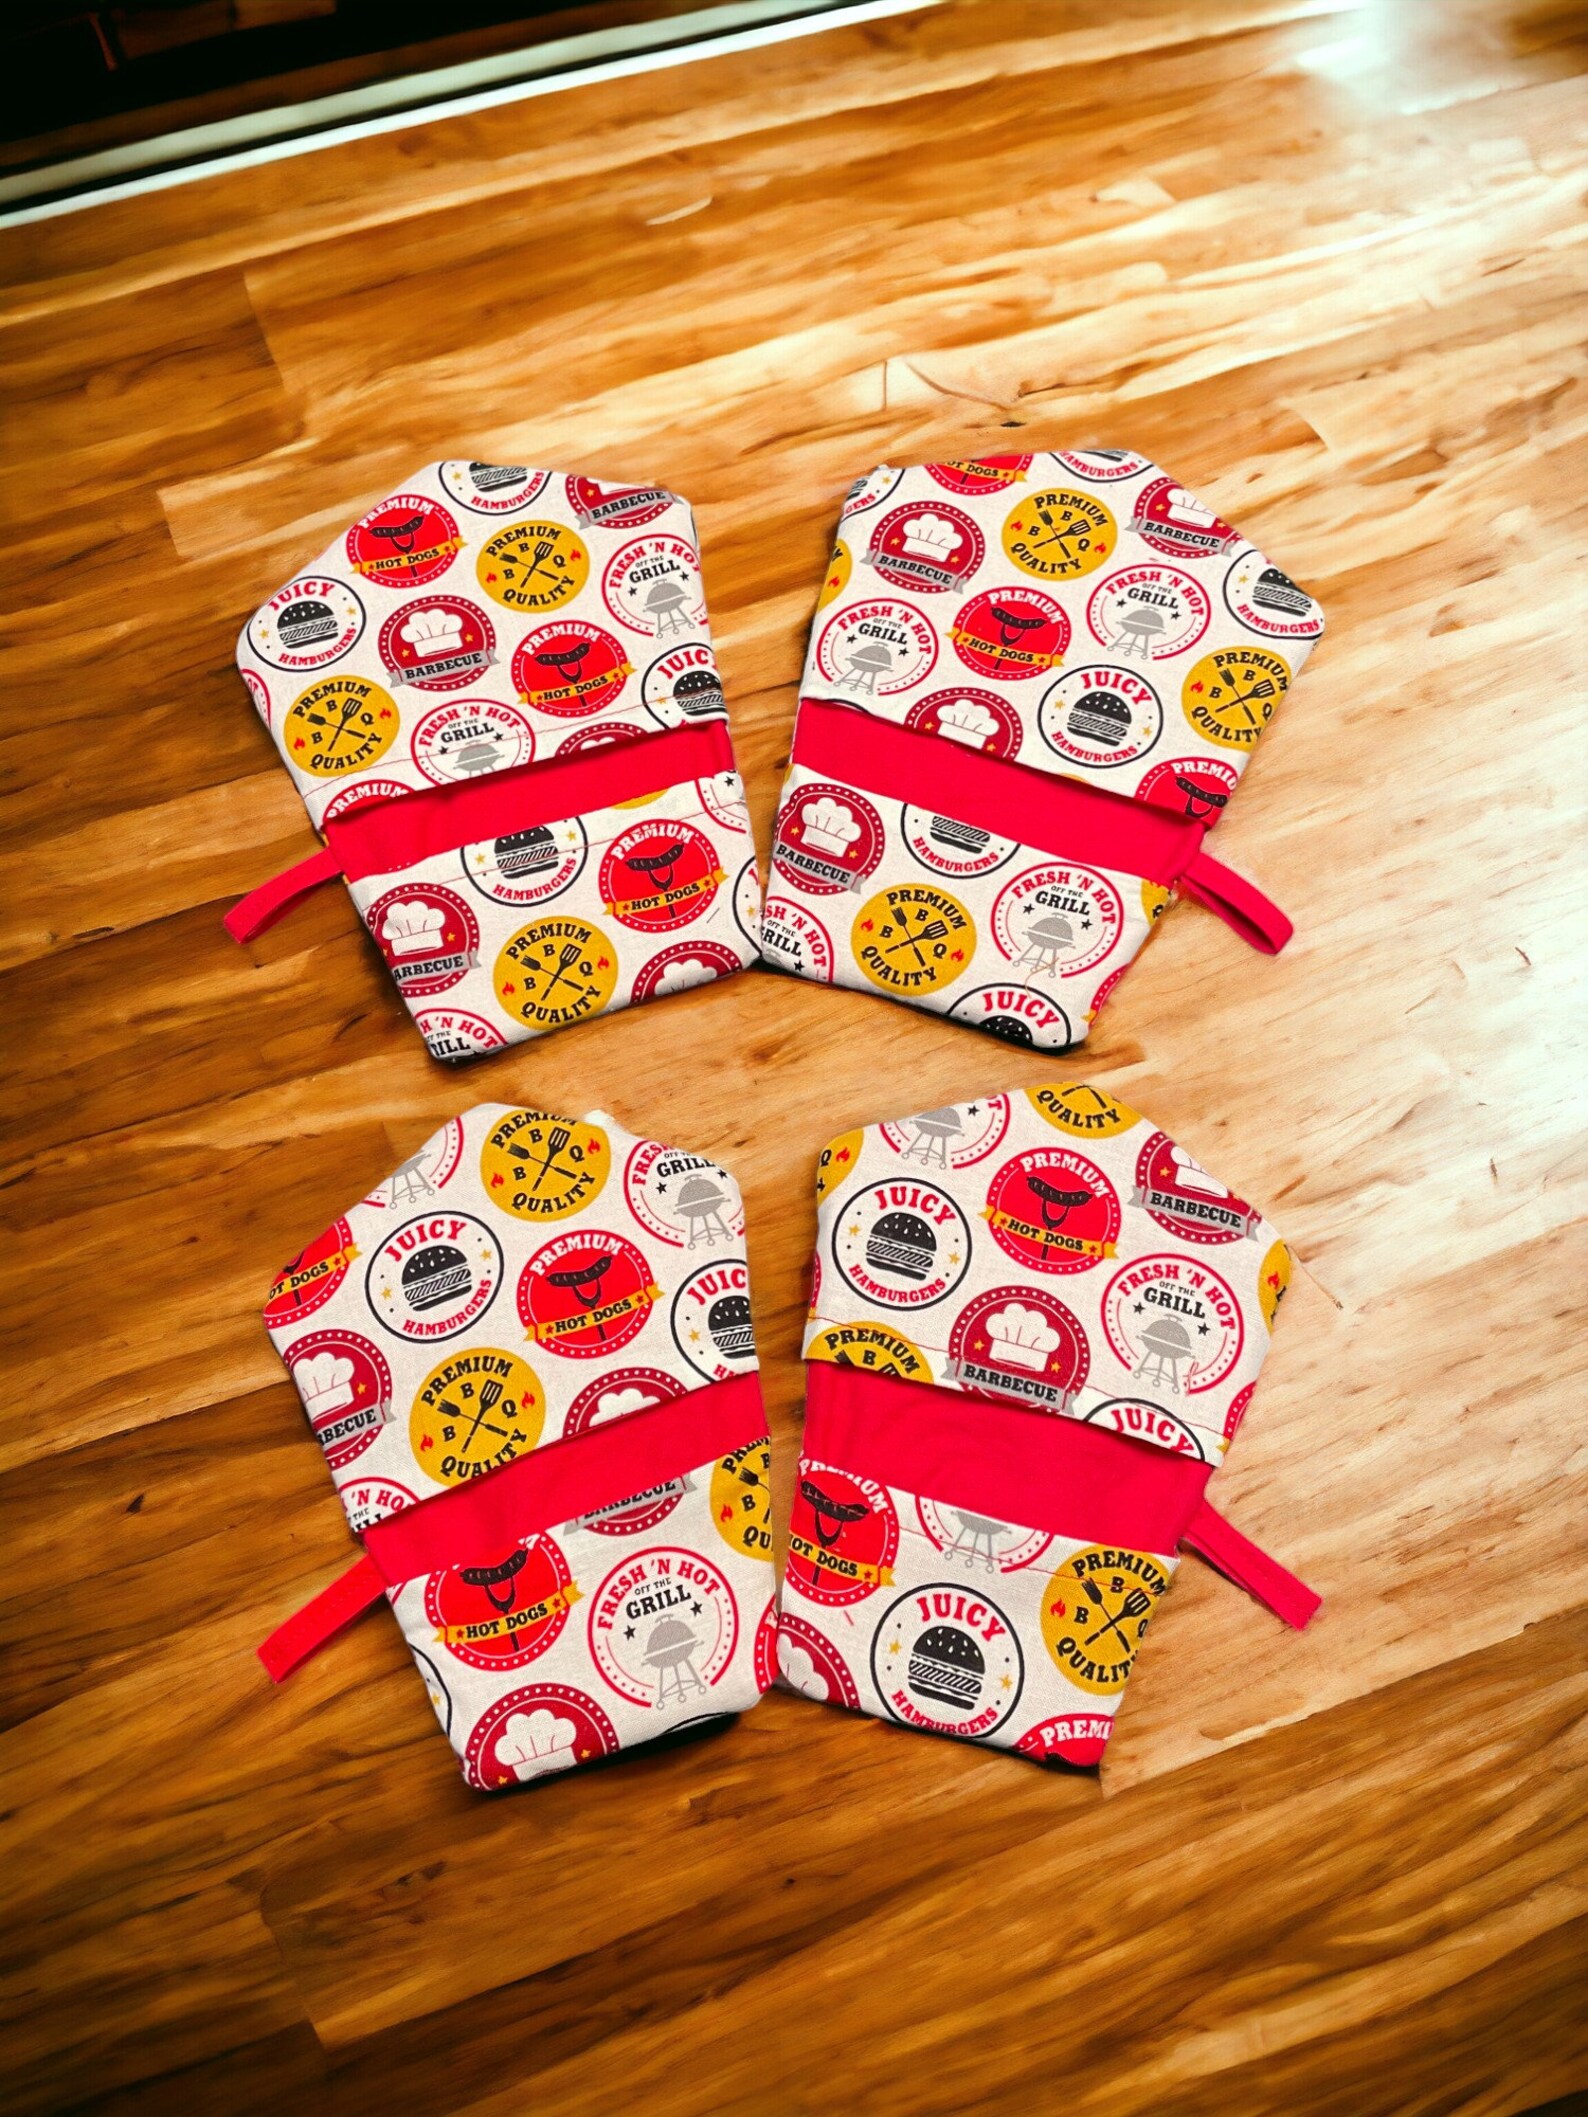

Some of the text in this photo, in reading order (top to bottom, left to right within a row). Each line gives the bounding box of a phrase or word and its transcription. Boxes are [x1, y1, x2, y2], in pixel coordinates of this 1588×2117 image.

[966, 465, 999, 478] DOGS
[470, 471, 544, 510] HAMBURGERS
[592, 491, 666, 519] BARBECUE
[358, 497, 434, 529] PREMIUM
[1034, 493, 1108, 527] PREMIUM
[486, 526, 562, 557] PREMIUM
[1028, 511, 1090, 551] B B Q
[1144, 522, 1220, 548] BARBECUE
[375, 548, 440, 570] HOT DOGS
[503, 543, 566, 579] B B Q
[609, 541, 665, 588] FRESH 'N
[629, 560, 681, 584] GRILL
[635, 556, 664, 568] OFF THE
[878, 555, 952, 584] BARBECUE
[1011, 542, 1082, 574] QUALITY
[267, 581, 335, 611] JUICY
[503, 575, 576, 606] QUALITY
[988, 590, 1064, 624] PREMIUM
[1106, 570, 1204, 615] FRESH 'N HOT
[1127, 586, 1179, 609] GRILL
[1157, 586, 1172, 594] THE
[837, 605, 931, 654] FRESH 'N HOT
[858, 624, 908, 644] GRILL
[873, 617, 887, 625] OFF
[1237, 604, 1320, 634] HAMBURGERS
[277, 627, 357, 665] HAMBURGERS
[522, 623, 600, 655] PREMIUM
[968, 638, 1034, 663] HOT DOGS
[404, 652, 482, 679] BARBECUE
[658, 650, 716, 679] JUIC
[1213, 651, 1288, 691] PREMIUM
[293, 681, 372, 717] PREMIUM
[543, 676, 608, 700] HOT DOGS
[1081, 671, 1152, 705] JUICY
[1209, 687, 1222, 698] B
[1244, 670, 1257, 681] B
[311, 700, 374, 744] B B Q
[418, 706, 521, 747] FRESH 'N HOT
[440, 723, 494, 743] GRILL
[310, 733, 382, 770] QUALITY
[1052, 731, 1138, 763] HAMBURGERS
[1171, 761, 1237, 790] PREMIU
[611, 822, 694, 860] PREMIUM
[913, 837, 999, 872] HAMBURGERS
[492, 857, 577, 900] HAMBURGERS
[776, 844, 851, 884] BARBECUE
[631, 882, 700, 911] HOT DOGS
[887, 889, 967, 930] PREMIUM
[1011, 871, 1116, 924] FRESH 'N HOT
[1035, 891, 1090, 915] GRILL
[506, 923, 592, 959] PREMIUM
[762, 928, 801, 956] RILL
[767, 920, 796, 937] OFF THE
[880, 909, 947, 958] B B Q
[804, 928, 827, 968] HOT
[861, 944, 937, 987] QUALITY
[524, 945, 593, 990] B B Q
[522, 985, 601, 1023] QUALITY
[983, 991, 1060, 1028] JUICY
[458, 1021, 502, 1048] HOT
[1036, 1090, 1121, 1129] QUALITY
[513, 1128, 585, 1180] B B Q
[511, 1172, 595, 1214] QUALITY
[1021, 1152, 1107, 1198] PREMIUM
[874, 1186, 957, 1225] JUICY
[1151, 1192, 1241, 1228] BARBECUE
[385, 1220, 467, 1262] JUICY
[1007, 1218, 1084, 1251] HOT DOGS
[530, 1234, 624, 1276] PREMIUM
[290, 1262, 329, 1287] DOGS
[687, 1269, 747, 1305] JUIC
[848, 1264, 947, 1303] HAMBURGERS
[1159, 1280, 1196, 1296] OFF THE
[402, 1279, 491, 1335] HAMBURGERS
[1117, 1263, 1179, 1296] FRESH
[1187, 1268, 1206, 1288] 'N
[1205, 1287, 1236, 1329] HOT
[1144, 1287, 1206, 1319] GRILL
[555, 1301, 632, 1332] HOT DOGS
[825, 1329, 920, 1373] PREMIUM
[422, 1356, 514, 1406] PREMIUM
[964, 1364, 1058, 1402] BARBECUE
[443, 1383, 518, 1441] B B Q
[1111, 1408, 1195, 1451] JUICY
[353, 1508, 369, 1520] THE
[792, 1537, 813, 1555] OT
[816, 1553, 858, 1577] DOGS
[1072, 1551, 1166, 1597] PREMIUM
[598, 1559, 720, 1630] FRESH 'N HOT
[626, 1584, 691, 1620] GRILL
[635, 1577, 671, 1595] OFF THE
[1075, 1577, 1125, 1624] B B
[466, 1604, 548, 1638] HOT DOGS
[916, 1594, 1006, 1642] JUICY
[1057, 1637, 1138, 1683] QUALIT
